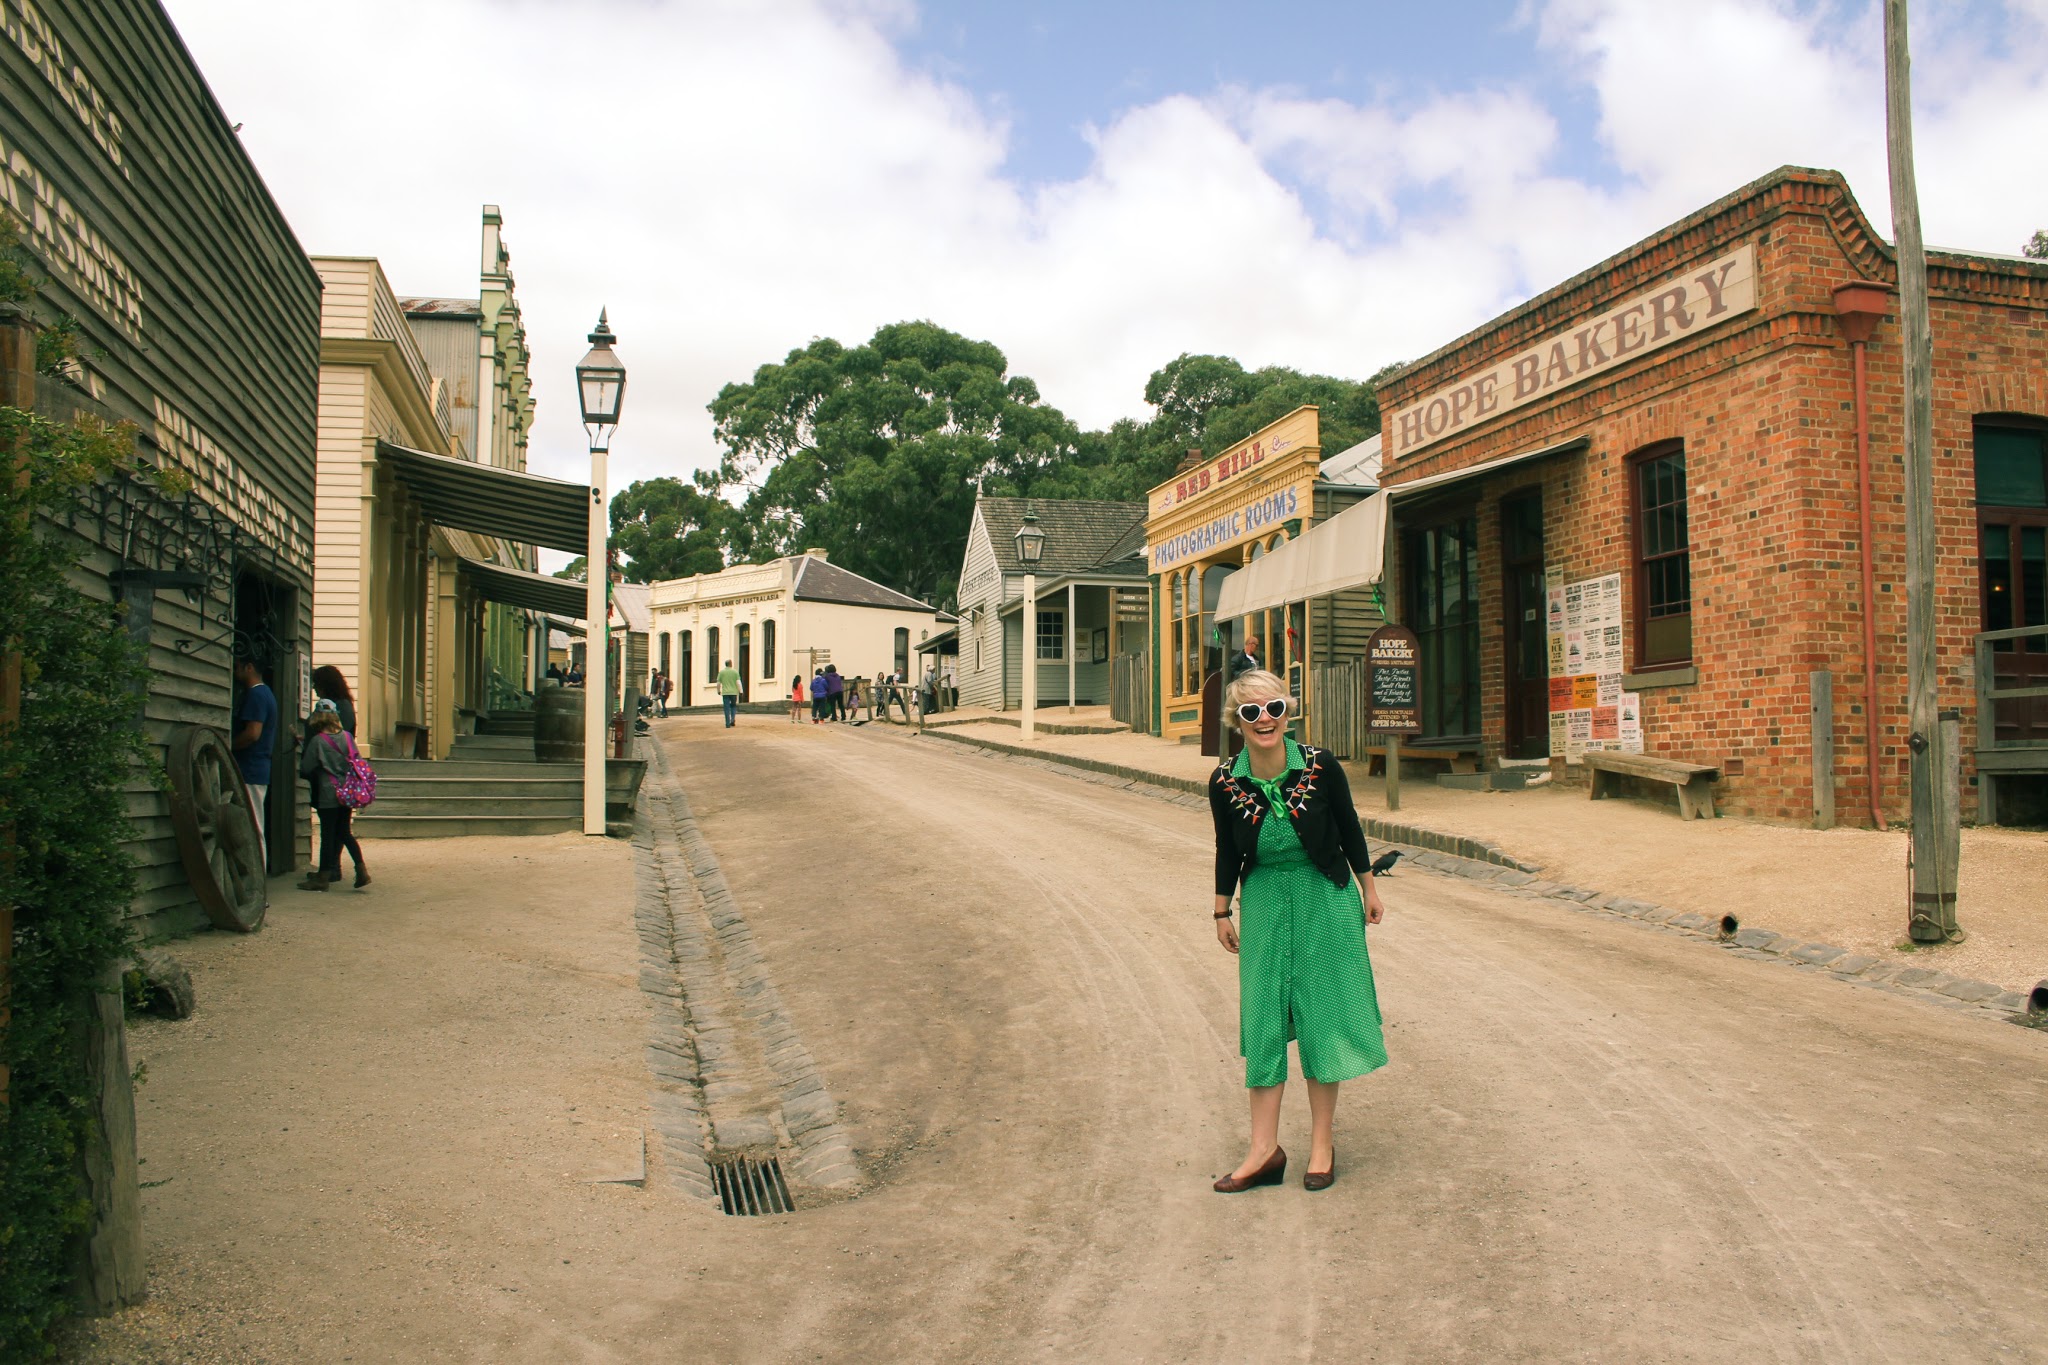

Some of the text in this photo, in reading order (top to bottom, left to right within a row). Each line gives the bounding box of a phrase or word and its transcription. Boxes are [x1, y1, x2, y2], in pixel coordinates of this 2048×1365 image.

[1399, 259, 1737, 450] HOPE BAKERY
[1176, 441, 1265, 503] RED HILL
[1155, 486, 1298, 569] PHOTOGRAPHIC ROOMS
[699, 602, 720, 610] COLONIAL
[743, 594, 779, 604] AUSTRALASIA
[1371, 648, 1414, 658] BAKERY
[1379, 639, 1407, 648] HOPE
